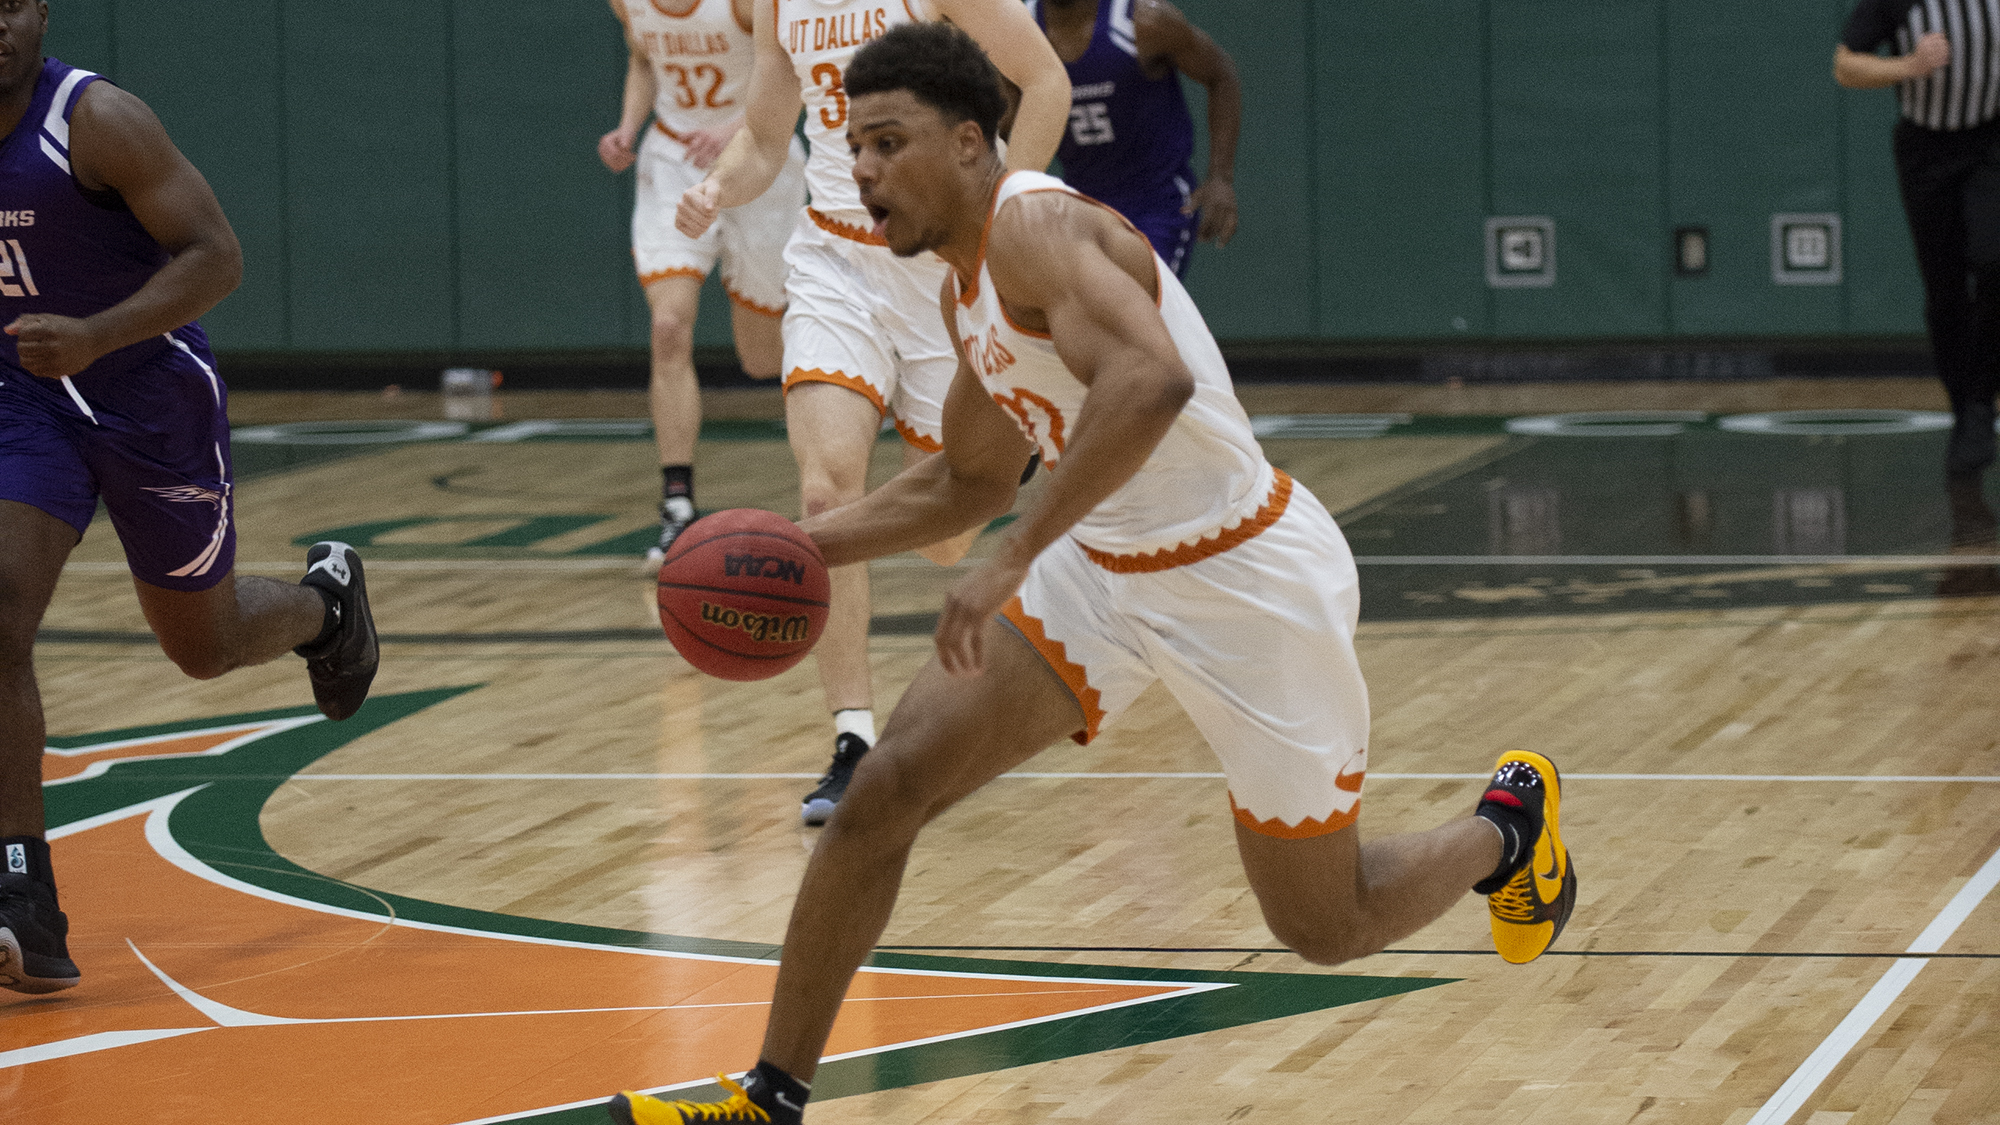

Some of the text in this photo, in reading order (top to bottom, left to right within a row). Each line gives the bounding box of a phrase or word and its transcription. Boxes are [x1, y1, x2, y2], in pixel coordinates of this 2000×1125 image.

[789, 8, 886, 54] UT DALLAS
[663, 63, 736, 109] 32
[811, 62, 847, 129] 3
[1070, 102, 1115, 146] 25
[724, 553, 805, 585] NCAA
[701, 601, 809, 642] Wilson
